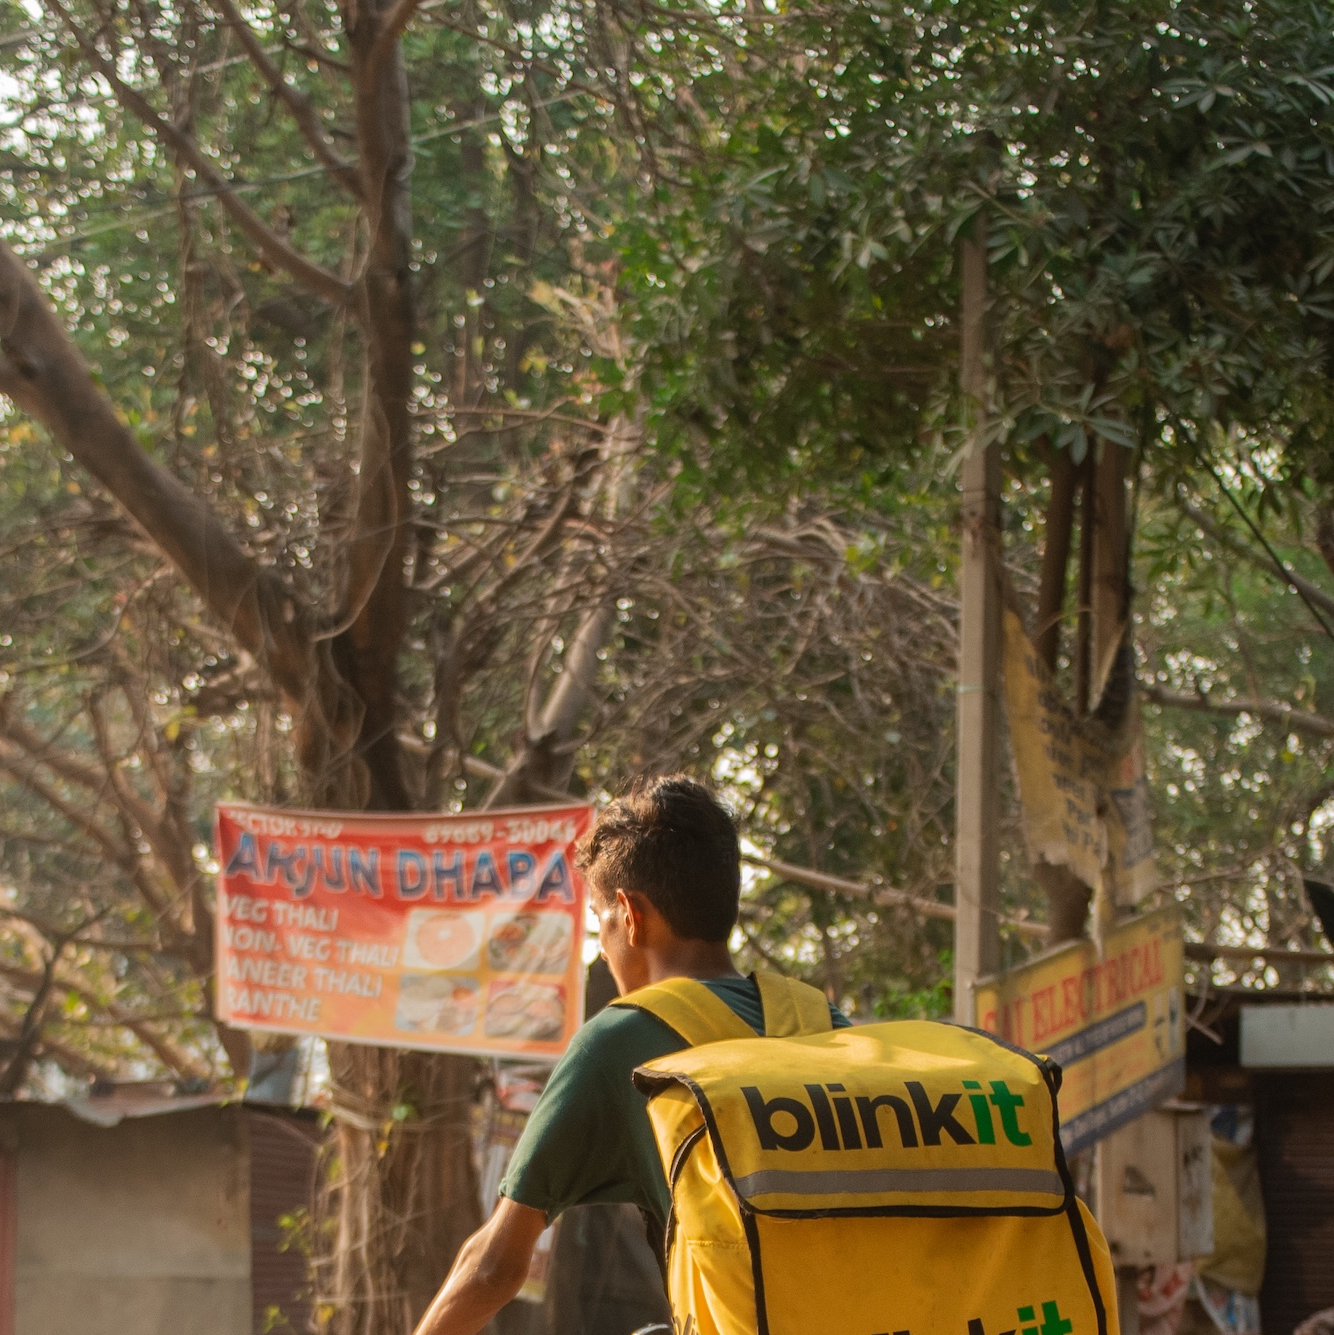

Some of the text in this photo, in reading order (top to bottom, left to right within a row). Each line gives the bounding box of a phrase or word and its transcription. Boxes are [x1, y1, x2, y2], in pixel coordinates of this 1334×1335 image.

[224, 830, 576, 905] ARJUN DHABA
[223, 894, 340, 931] VEG THALI
[287, 935, 331, 961] VEG
[335, 939, 400, 968] THALI
[312, 966, 383, 998] THALI
[741, 1080, 1033, 1151] blinkit
